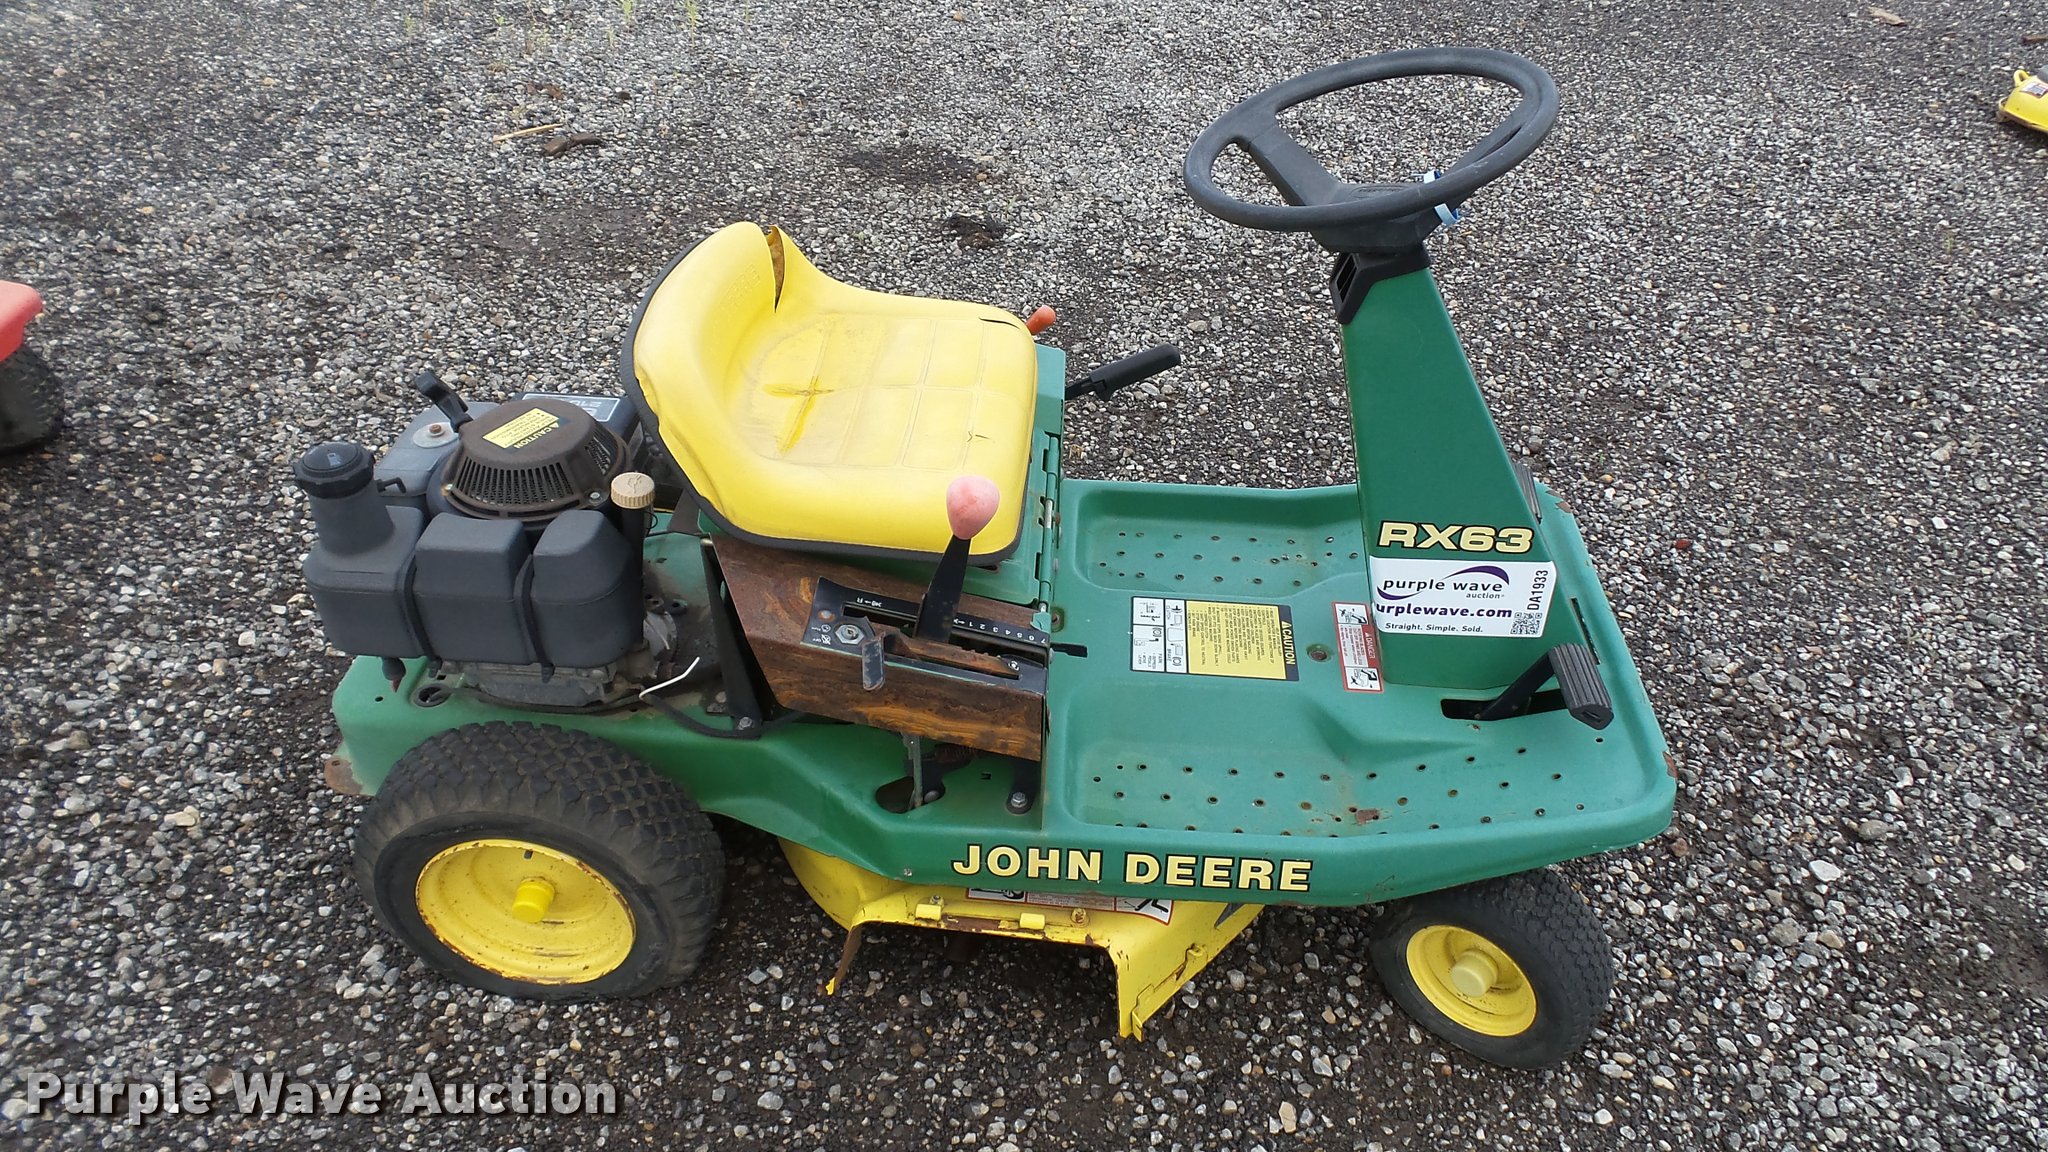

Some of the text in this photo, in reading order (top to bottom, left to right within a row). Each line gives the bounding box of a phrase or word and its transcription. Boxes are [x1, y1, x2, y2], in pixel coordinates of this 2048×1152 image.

[514, 427, 552, 448] CAUTION
[1376, 521, 1534, 554] RX63
[1383, 578, 1502, 592] purple wave
[1527, 570, 1548, 610] DA1933
[1376, 603, 1512, 618] urplewave.com
[1385, 622, 1422, 630] Straight.
[1426, 624, 1458, 632] Simple.
[1282, 630, 1296, 664] CAUTION
[952, 844, 1312, 892] JOHN DEERE
